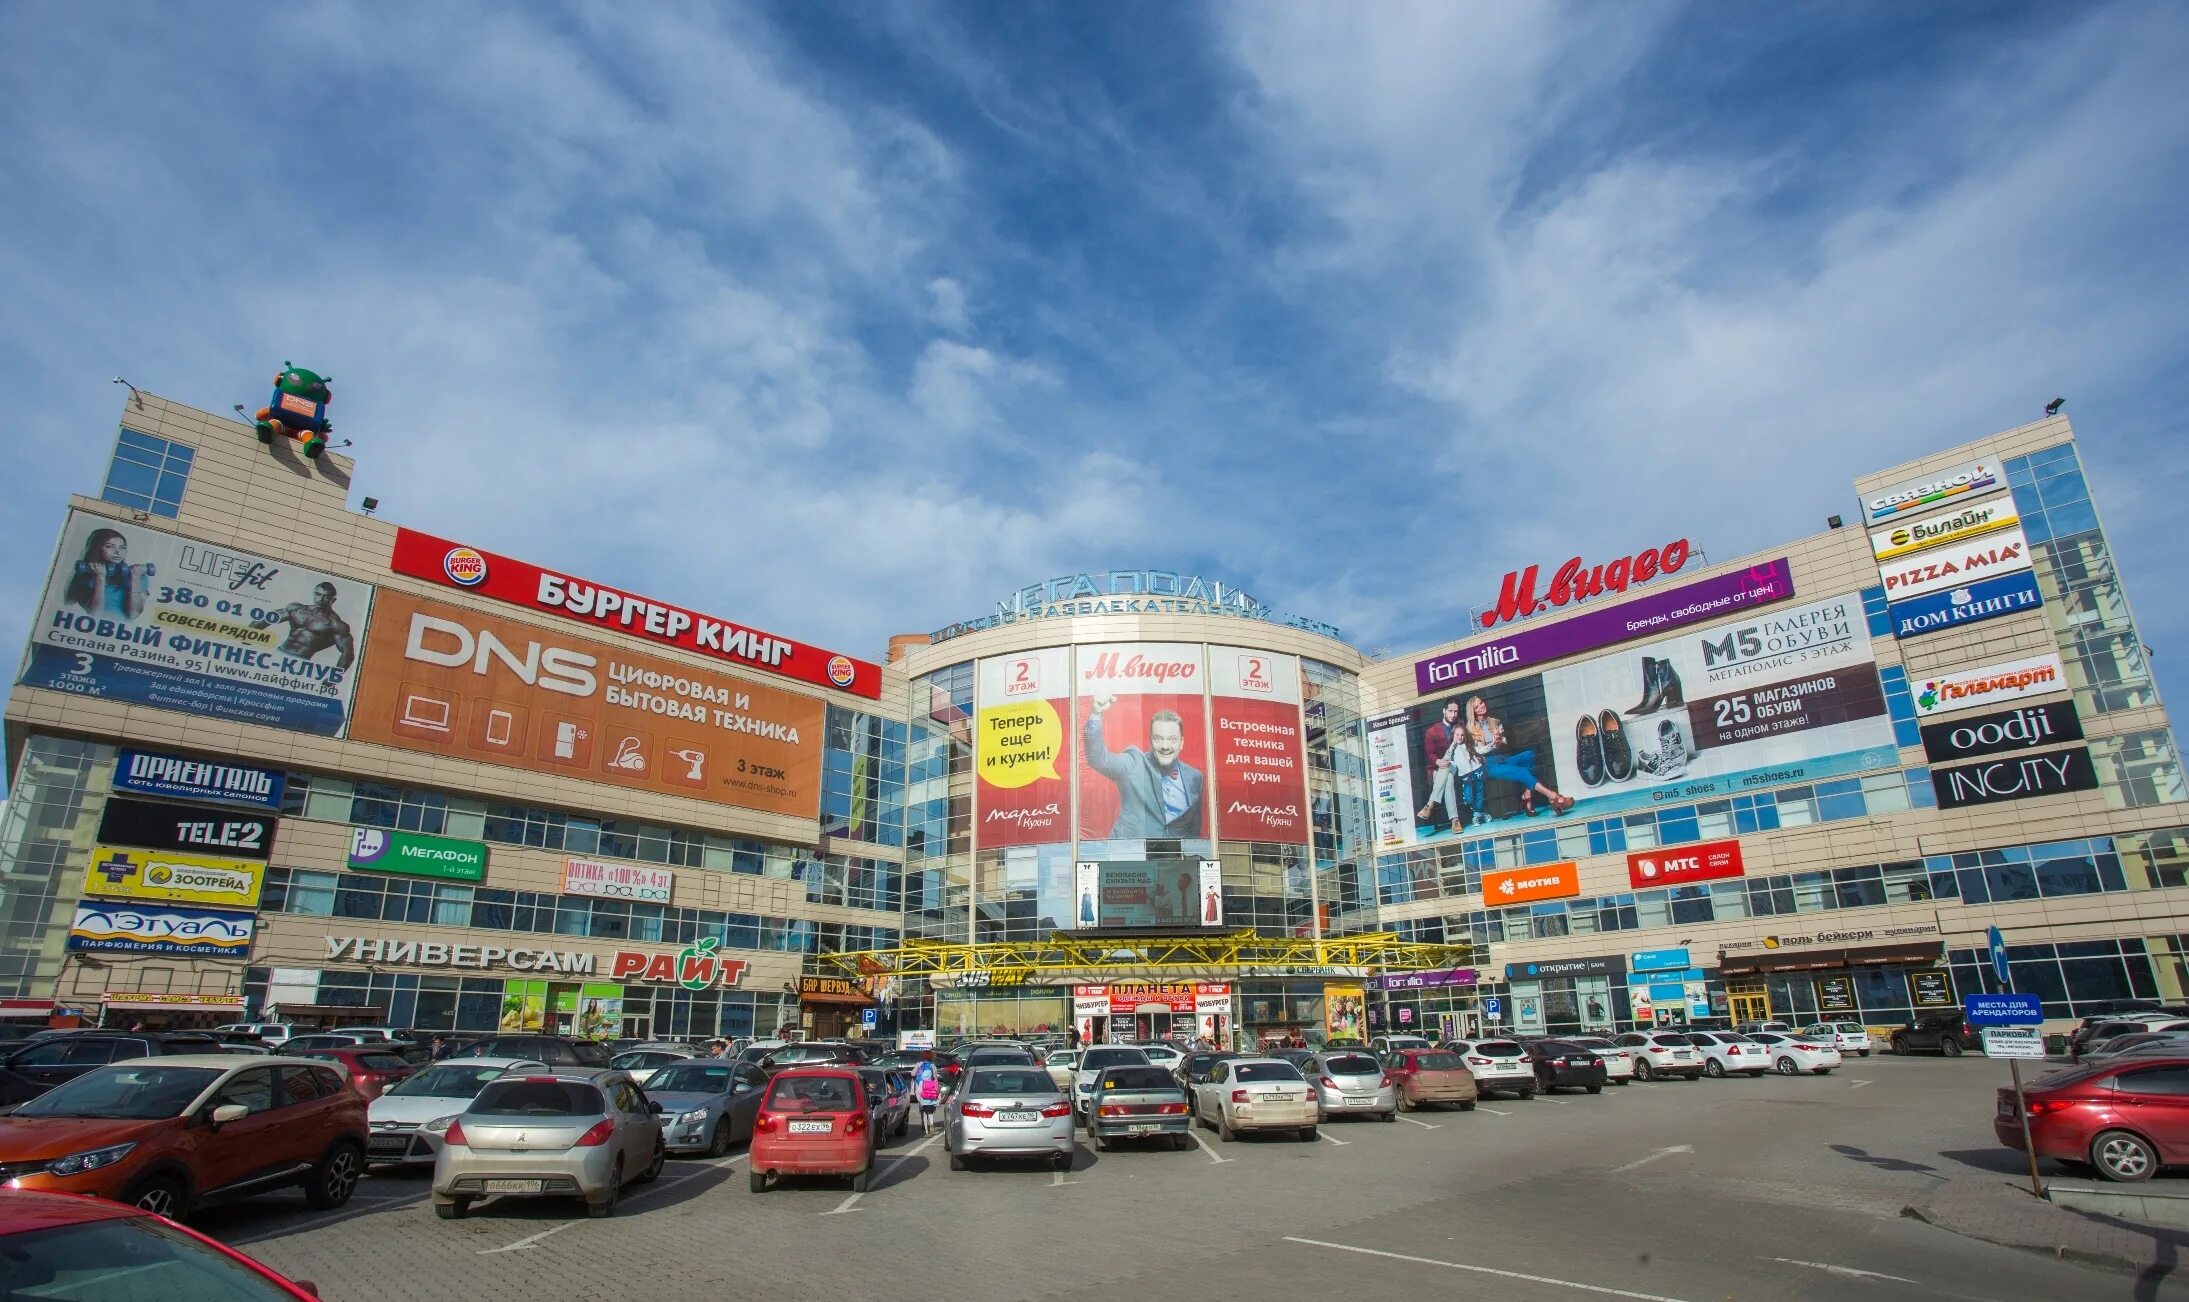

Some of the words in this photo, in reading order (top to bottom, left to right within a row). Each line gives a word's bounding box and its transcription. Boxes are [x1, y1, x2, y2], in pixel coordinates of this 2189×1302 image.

[1913, 510, 1988, 539] Билайн
[179, 546, 251, 582] LIFE
[229, 562, 279, 590] fit
[450, 556, 481, 565] BURGER
[450, 563, 482, 574] KING
[1885, 561, 1960, 591] PIZZA
[1964, 545, 2019, 571] MIA
[1481, 538, 1690, 628] М.видео
[156, 586, 209, 608] 380
[215, 600, 243, 617] 01
[250, 607, 281, 624] 00
[1626, 607, 1669, 633] Бренды,
[1671, 595, 1731, 621] свободные
[1733, 589, 1747, 603] от
[1748, 583, 1774, 602] цен!
[1900, 608, 1950, 635] ДОМ
[1953, 589, 2036, 621] КНИГИ
[157, 611, 217, 632] СОВСЕМ
[219, 624, 271, 645] РЯДОМ
[537, 573, 691, 638] БУРГЕР
[696, 618, 792, 666] КИНГ
[1764, 604, 1847, 635] ГАЛЕРЕЯ
[1767, 621, 1851, 651] ОБУВИ
[52, 610, 164, 648] НОВЫЙ
[169, 632, 345, 684] ФИТНЕС-КЛУБ
[404, 612, 597, 697] DNS
[48, 629, 116, 656] Степана
[119, 642, 181, 667] Разина,
[184, 658, 203, 672] 95
[215, 664, 339, 697] www.лайффит.рф
[69, 652, 95, 675] 3
[831, 662, 851, 670] BURGER
[1016, 662, 1029, 682] 2
[1085, 652, 1196, 684] М.видео
[1249, 659, 1262, 679] 2
[1428, 643, 1519, 684] familia
[1709, 655, 1793, 683] МЕГАПОЛИС
[1801, 652, 1807, 661] 5
[1811, 641, 1853, 659] ЭТАЖ
[59, 672, 97, 685] этажа
[831, 668, 852, 678] KING
[1242, 677, 1271, 690] этаж
[48, 680, 84, 693] 1000
[113, 662, 182, 682] Тренажерный
[184, 676, 200, 685] зал
[236, 686, 285, 702] групповых
[285, 696, 329, 709] программ
[608, 661, 729, 707] ЦИФРОВАЯ
[735, 692, 750, 711] И
[1008, 681, 1037, 694] этаж
[1753, 677, 1836, 705] МАГАЗИНОВ
[1940, 667, 2055, 701] Галамарт
[149, 681, 168, 690] Зал
[168, 686, 238, 701] единоборств
[239, 697, 285, 711] Кроссфит
[149, 693, 209, 710] Фитнес-бар
[215, 704, 254, 717] Финская
[255, 711, 281, 722] сауна
[605, 685, 707, 724] БЫТОВАЯ
[712, 709, 800, 745] ТЕХНИКА
[1713, 696, 1751, 728] 25
[1756, 699, 1802, 719] ОБУВИ
[990, 713, 1044, 731] Теперь
[1219, 717, 1295, 737] Встроенная
[1719, 731, 1732, 741] на
[1734, 724, 1769, 740] одном
[1772, 714, 1810, 731] этаже!
[1950, 708, 2054, 749] oodji
[1000, 732, 1032, 749] еще
[1233, 736, 1285, 751] техника
[986, 756, 996, 767] и
[999, 746, 1051, 769] кухни!
[1225, 752, 1251, 766] для
[1254, 752, 1294, 769] вашей
[130, 753, 272, 795] ОРИЕНТАЛЬ
[736, 759, 746, 773] 3
[749, 765, 786, 781] этаж
[1242, 771, 1282, 785] кухни
[1742, 769, 1805, 787] m5shoes.ru
[1949, 754, 2071, 800] INCITY
[128, 778, 153, 788] сеть
[155, 781, 222, 798] ювелирных
[223, 791, 269, 802] салонов
[723, 776, 797, 799] www.dns-shop.ru
[1022, 815, 1053, 830] Кухни
[1265, 814, 1293, 828] Кухни
[176, 821, 264, 850] TELE2
[1664, 857, 1700, 873] МТС
[1708, 852, 1730, 861] салон
[443, 864, 455, 874] 1-й
[456, 866, 476, 875] этаж
[568, 861, 604, 881] ОПТИКА
[650, 872, 658, 886] 4
[174, 874, 245, 891] ЗООТРЕЙД
[1516, 876, 1560, 890] МОТИВ
[81, 940, 163, 951] ПАРФЮМЕРИЯ
[175, 945, 238, 955] КОСМЕТИКА
[1782, 936, 1813, 946] поль
[1817, 929, 1873, 943] бейкери
[324, 935, 597, 973] УНИВЕРСАМ
[1296, 966, 1336, 974] СБЕРБАНК
[1539, 962, 1586, 974] открытие
[803, 978, 818, 992] БАР
[820, 979, 850, 995] ШЕРВУД
[1112, 984, 1191, 994] ПЛАНЕТА
[1388, 976, 1423, 988] familia
[1076, 1000, 1109, 1010] ЧИЗБУРГЕР
[1196, 999, 1229, 1008] ЧИЗБУРГЕР
[1489, 1001, 1497, 1011] P
[1972, 1009, 2037, 1017] АРЕНДАТОРОВ
[865, 1011, 874, 1021] P
